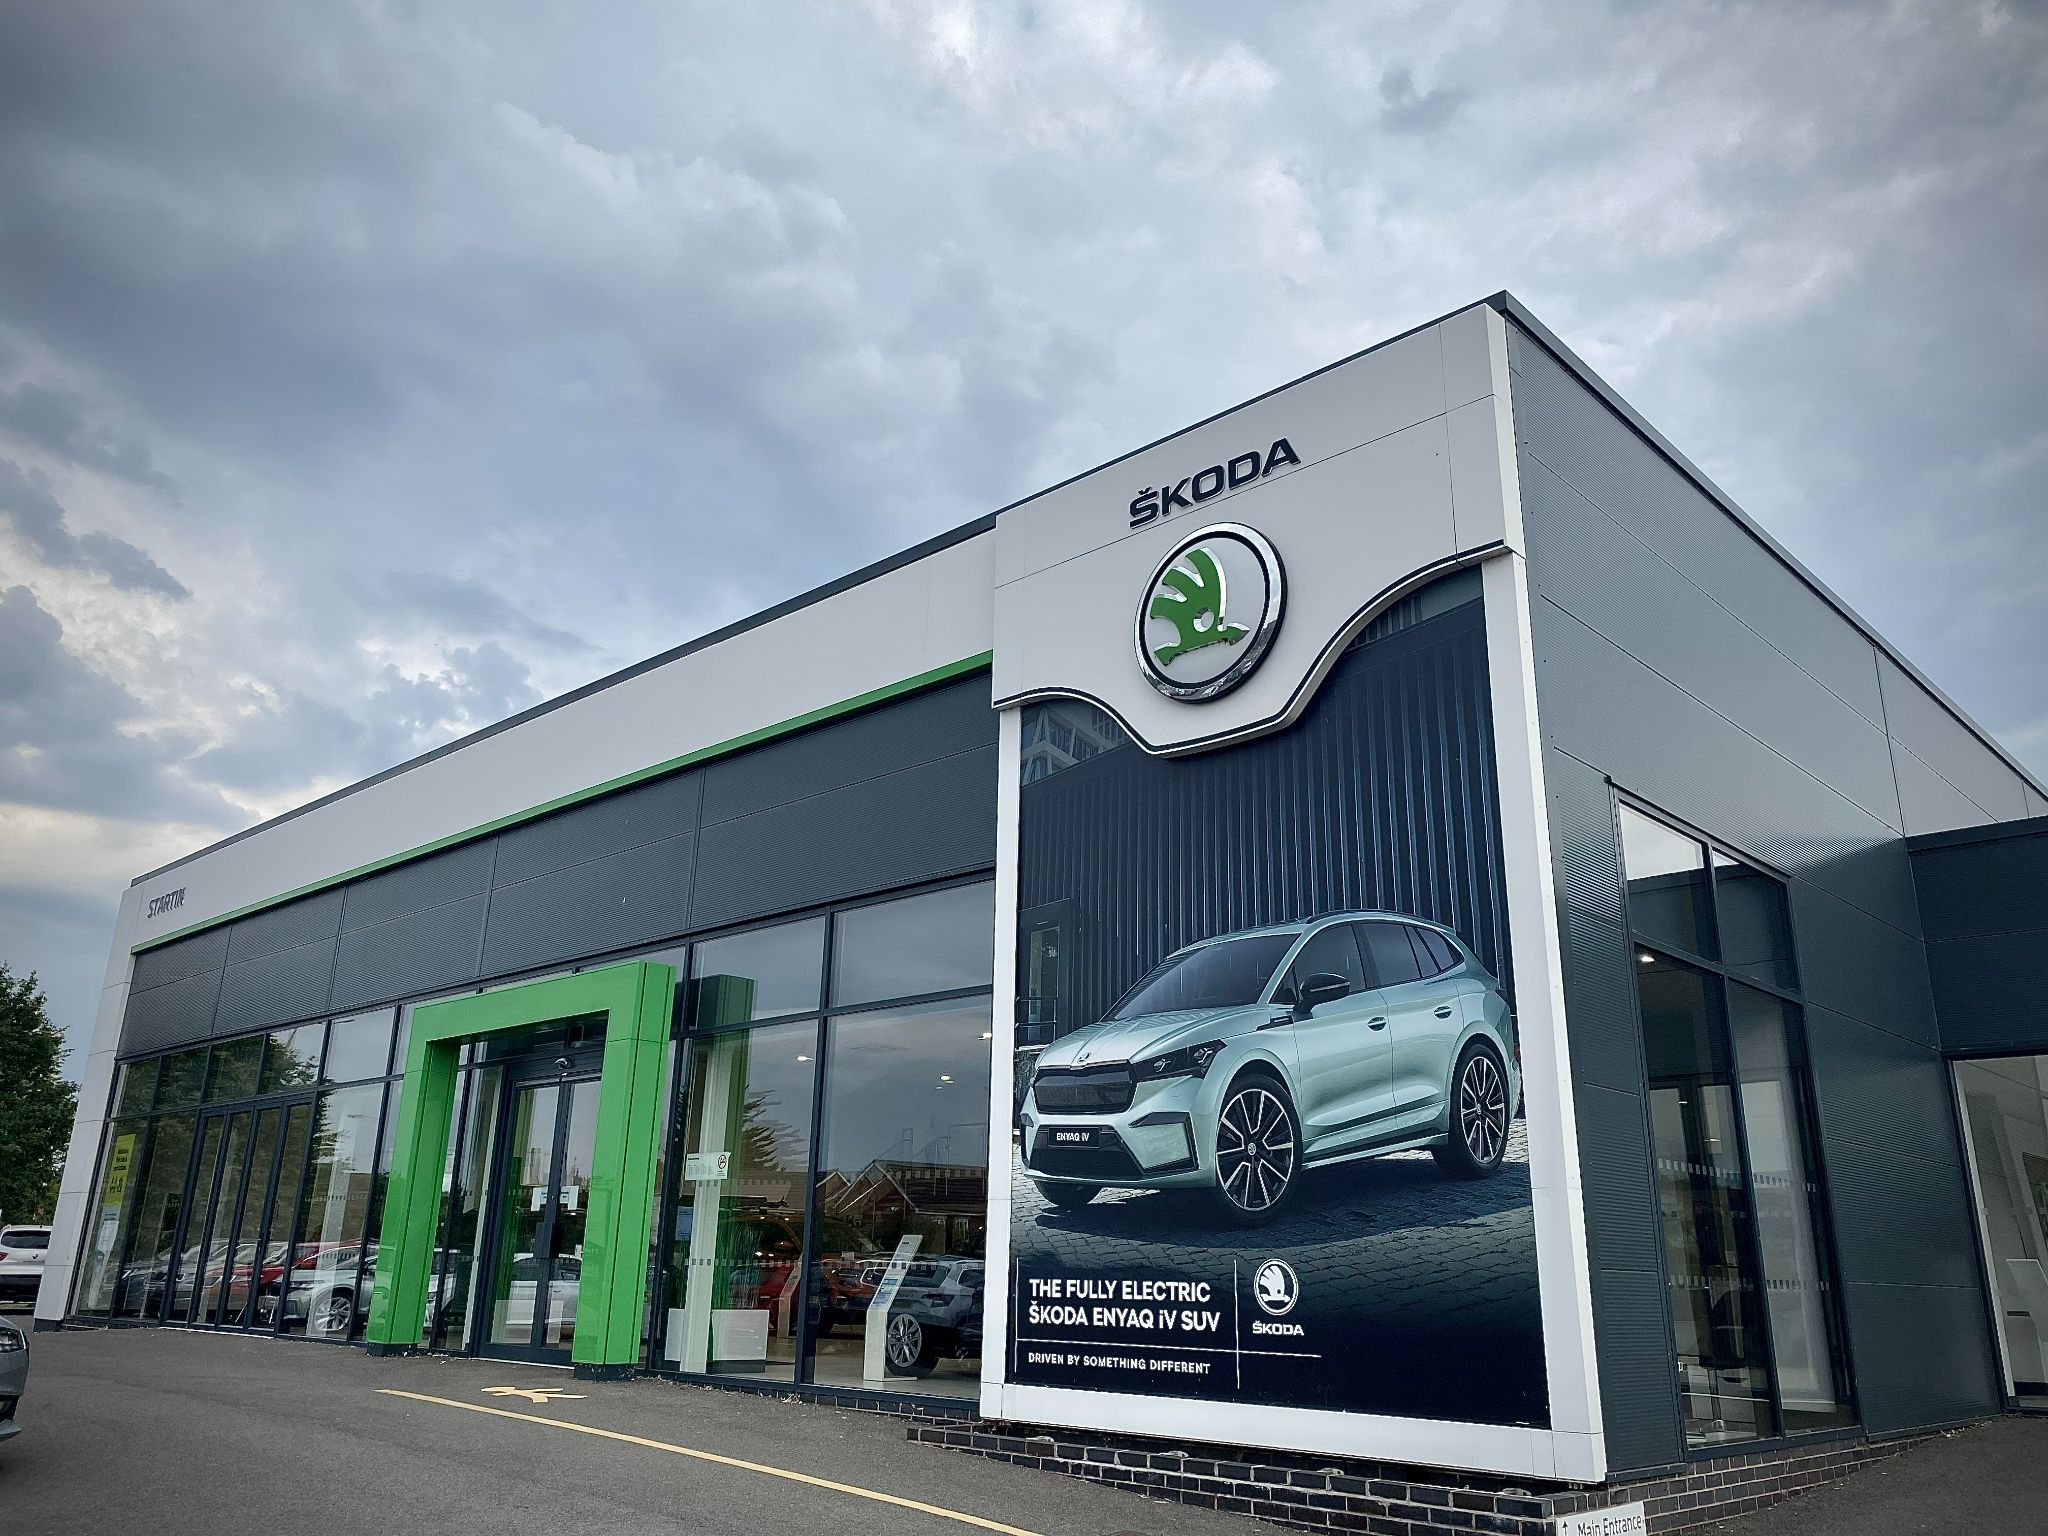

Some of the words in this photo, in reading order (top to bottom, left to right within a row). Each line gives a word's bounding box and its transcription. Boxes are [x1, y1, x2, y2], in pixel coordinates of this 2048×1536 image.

[1129, 437, 1301, 529] ŠKODA
[146, 886, 187, 919] STARTIN
[1056, 1132, 1081, 1142] ENYAQ
[1029, 1278, 1062, 1298] THE
[1066, 1279, 1118, 1299] FULLY
[1122, 1280, 1211, 1303] ELECTRIC
[1029, 1299, 1089, 1326] ŠKODA
[1093, 1306, 1154, 1329] ENYAQ
[1181, 1310, 1221, 1332] SUV
[1252, 1320, 1305, 1336] ŠKODA
[1028, 1352, 1064, 1365] DRIVEN
[1067, 1354, 1080, 1366] BY
[1083, 1355, 1146, 1370] SOMETHING
[1149, 1359, 1211, 1375] DIFFERENT
[1577, 1519, 1601, 1536] Main
[1602, 1515, 1642, 1536] Entrance
